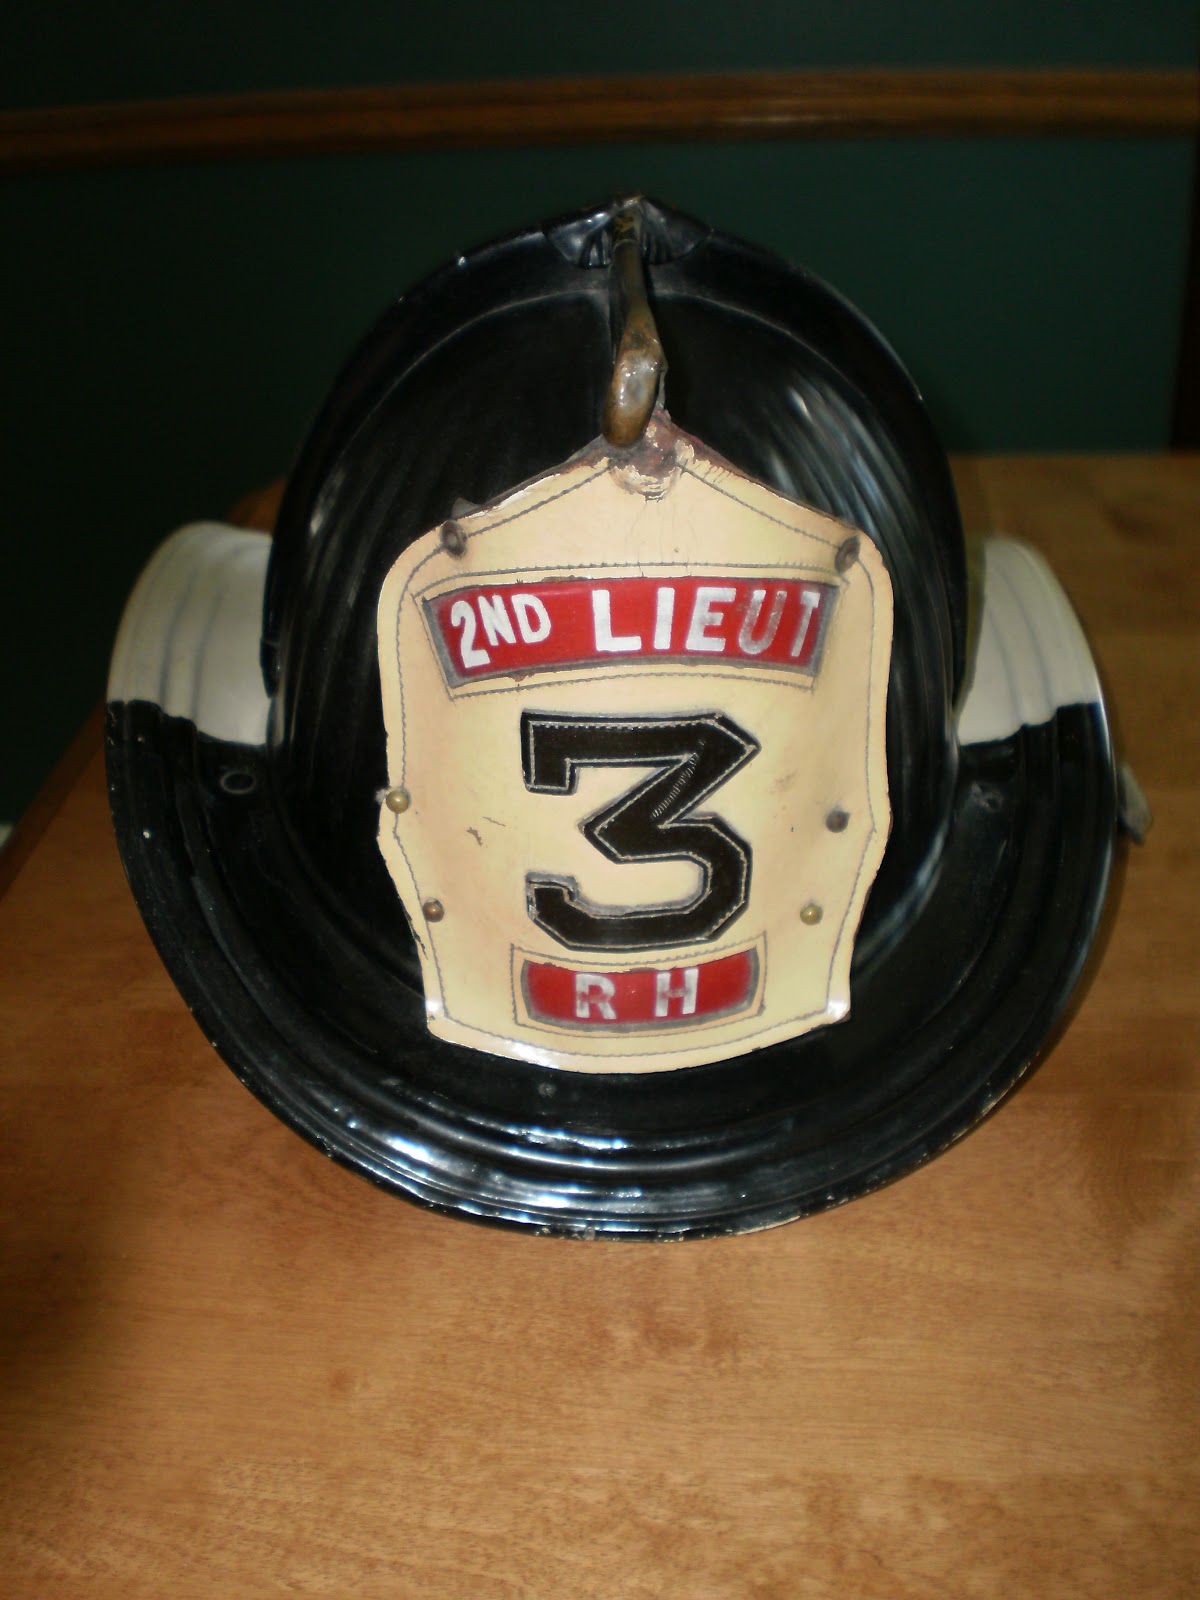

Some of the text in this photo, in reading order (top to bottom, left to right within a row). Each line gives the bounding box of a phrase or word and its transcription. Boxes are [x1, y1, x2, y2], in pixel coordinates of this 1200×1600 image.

[451, 587, 820, 668] 2ND LIEUT
[520, 708, 762, 953] 3
